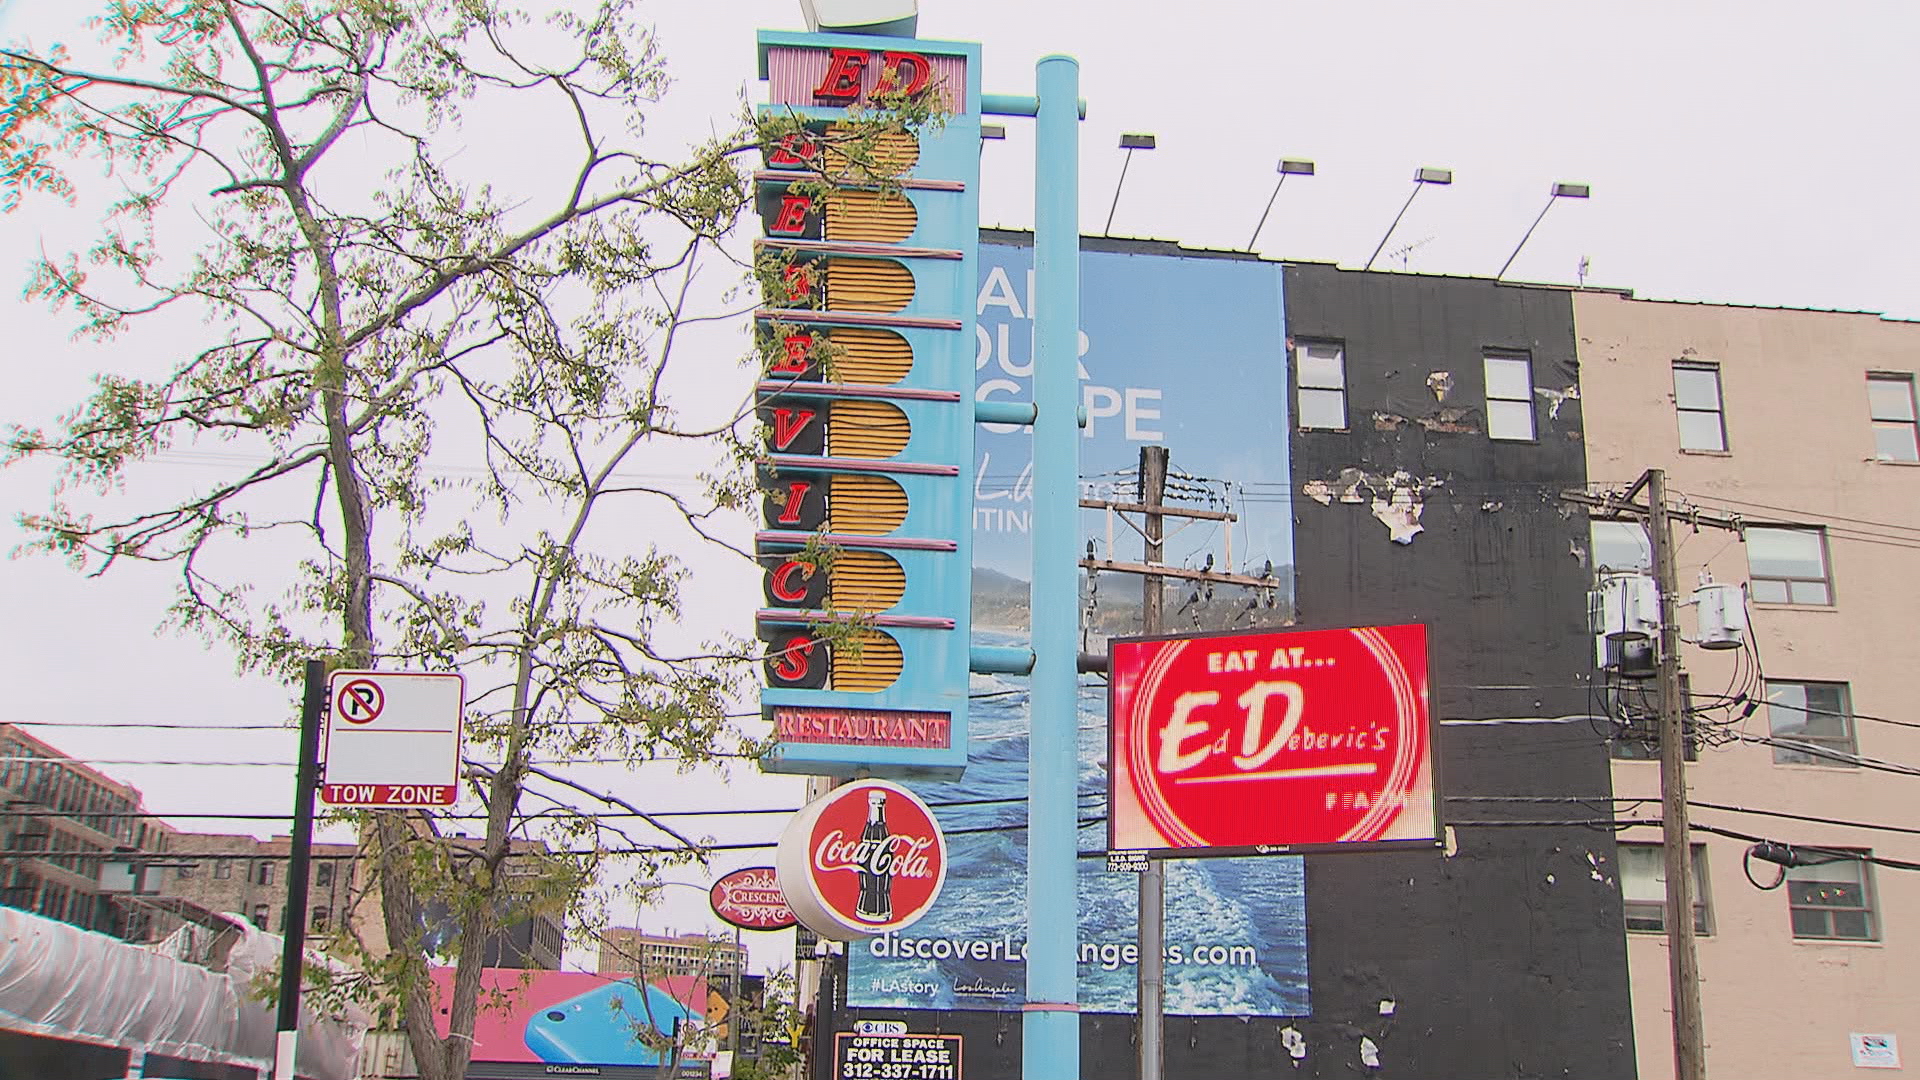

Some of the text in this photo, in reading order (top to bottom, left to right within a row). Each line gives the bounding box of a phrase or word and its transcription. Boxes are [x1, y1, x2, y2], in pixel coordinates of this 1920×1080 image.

[813, 48, 931, 99] ED
[1208, 650, 1258, 673] EAT
[778, 711, 949, 743] RESTAURANT
[1158, 691, 1230, 773] Ed
[330, 785, 445, 804] TOW ZONE
[814, 829, 934, 879] Coca-Cola
[731, 890, 786, 904] CRESCEN
[871, 977, 940, 997] #LAstory
[875, 1023, 901, 1034] CBS
[852, 1038, 945, 1050] OFFICE SPACE
[846, 1048, 951, 1065] FOR LEASE
[843, 1062, 954, 1080] 312-337-1711
